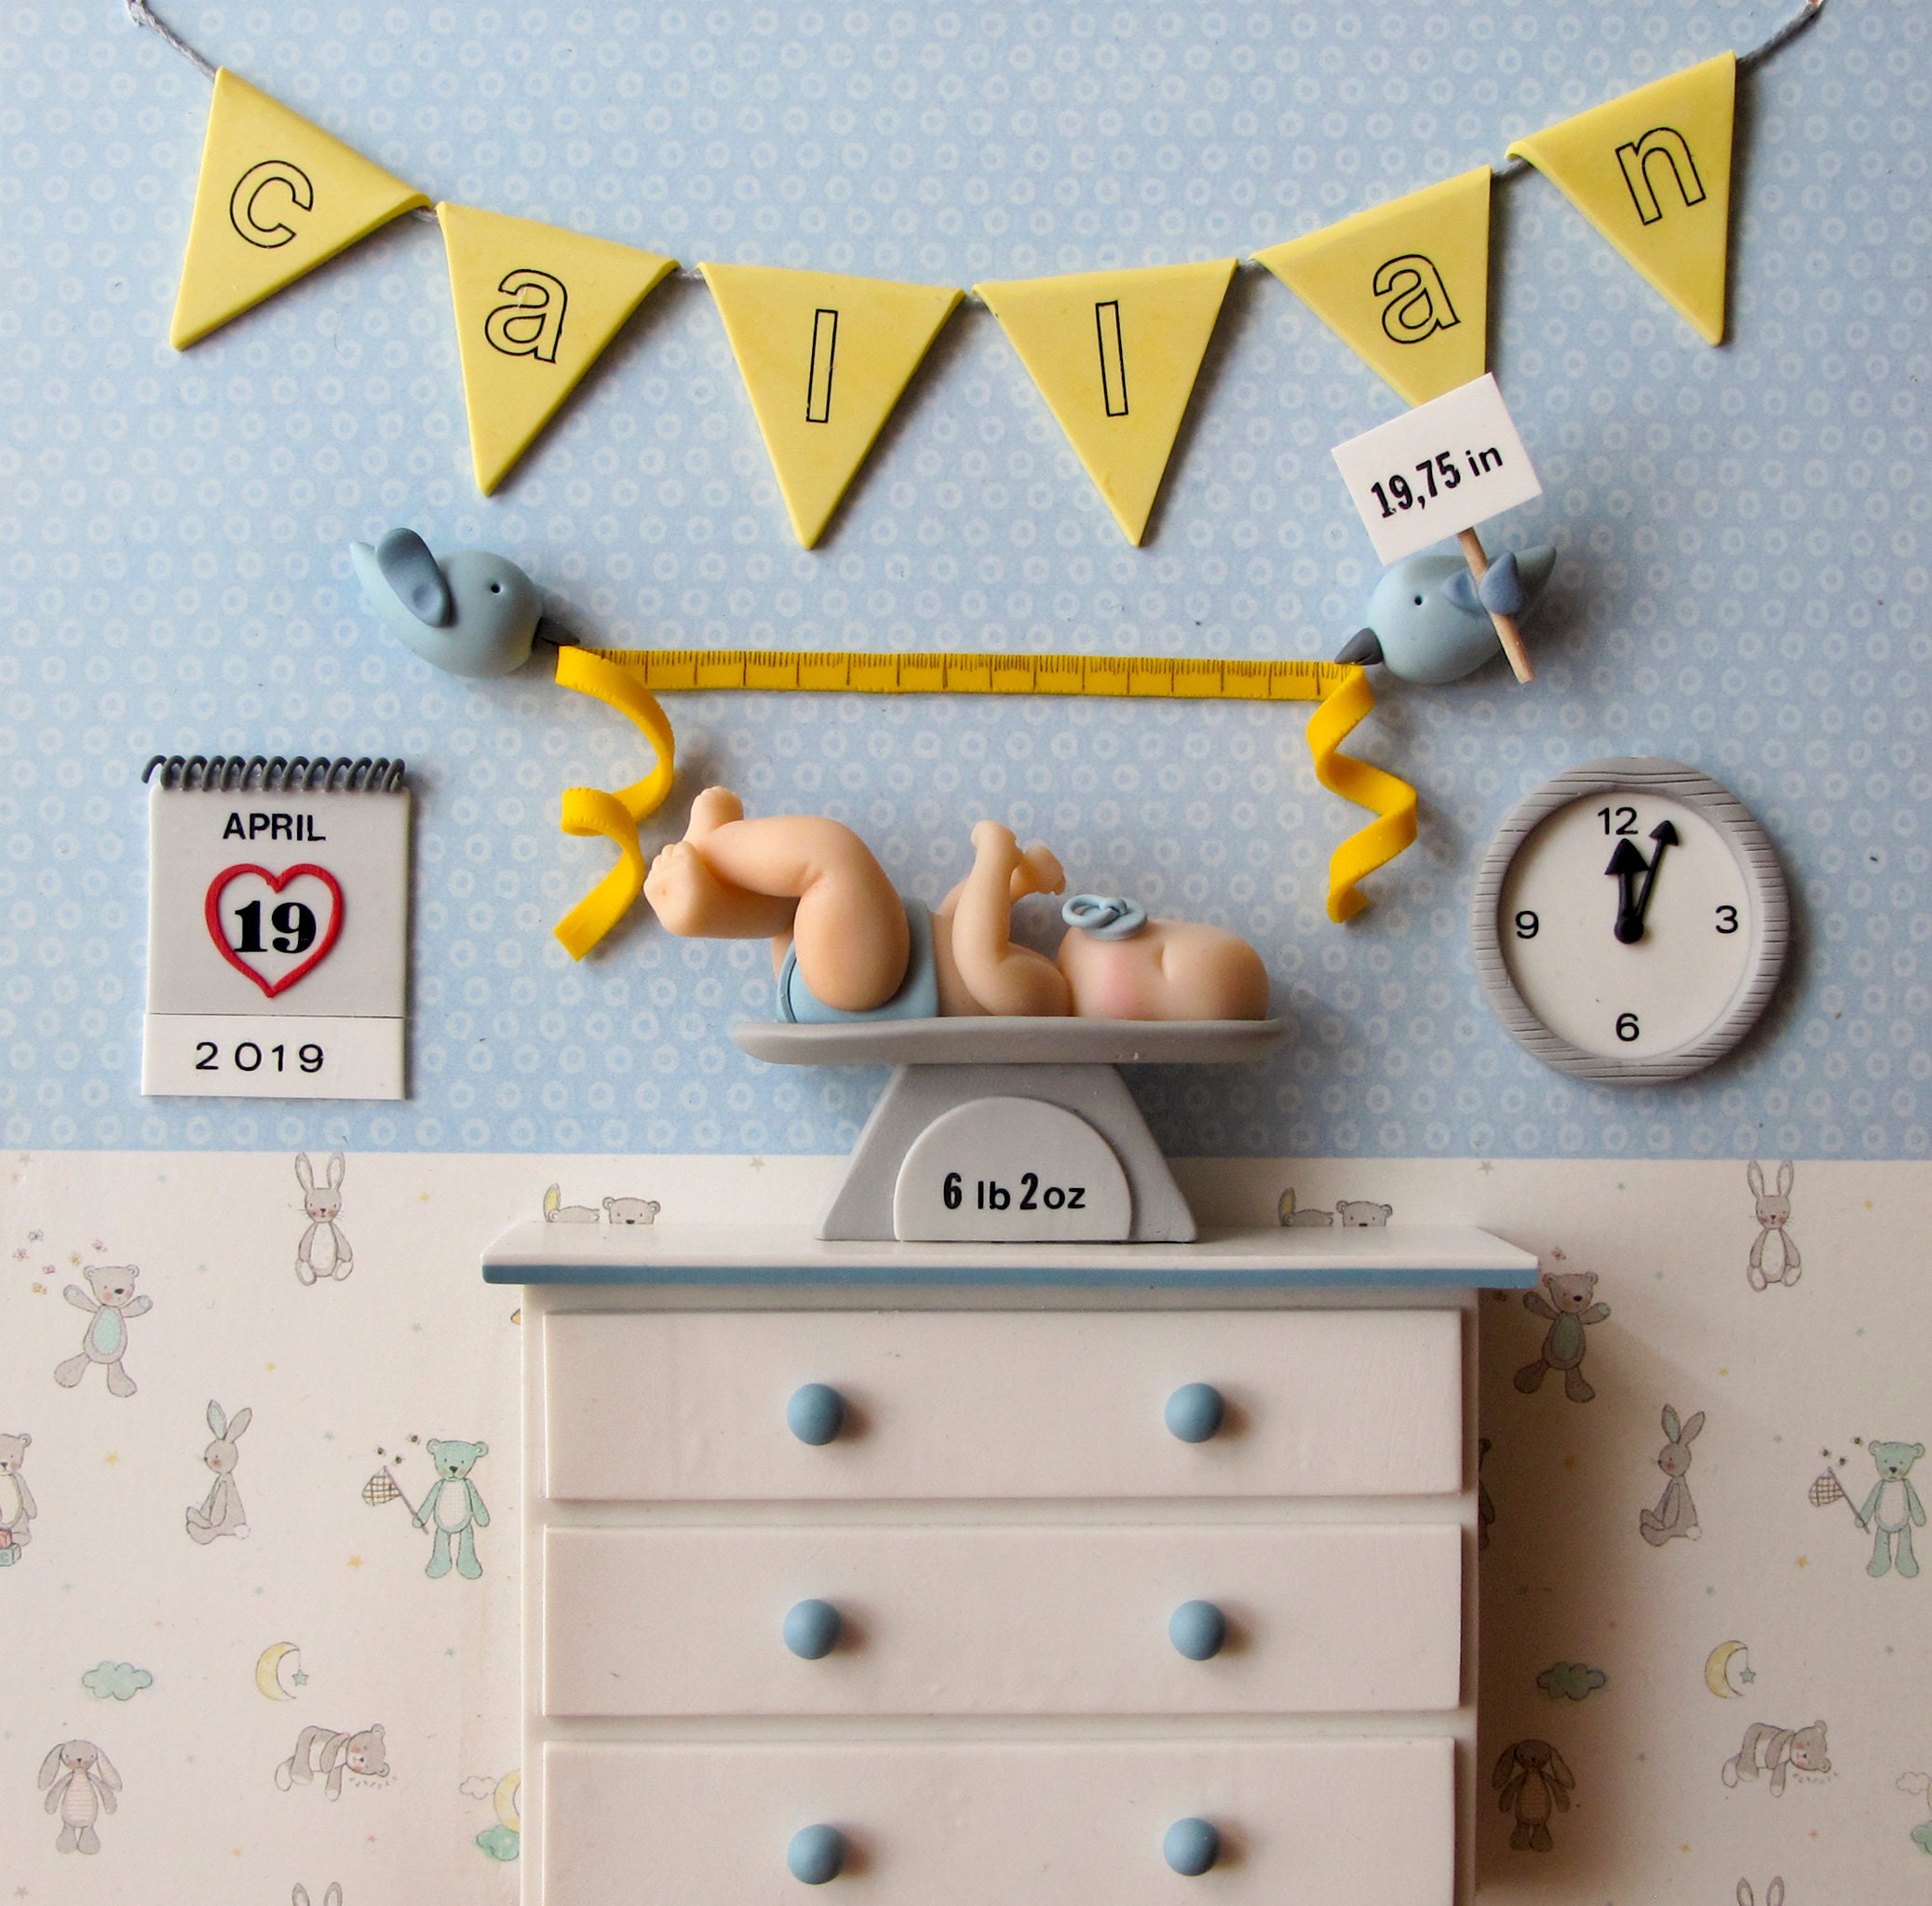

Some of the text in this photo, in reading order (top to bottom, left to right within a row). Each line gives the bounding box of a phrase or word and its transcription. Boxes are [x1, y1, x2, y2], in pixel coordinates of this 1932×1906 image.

[1371, 447, 1504, 519] 19,75 in
[223, 812, 327, 842] APRIL
[1597, 806, 1639, 836] 12
[234, 899, 317, 954] 19
[1514, 910, 1540, 939] 9
[1715, 904, 1739, 935] 3
[1615, 1012, 1641, 1042] 6
[195, 1041, 324, 1074] 2019
[943, 1171, 963, 1210] 6
[977, 1181, 1011, 1210] lb
